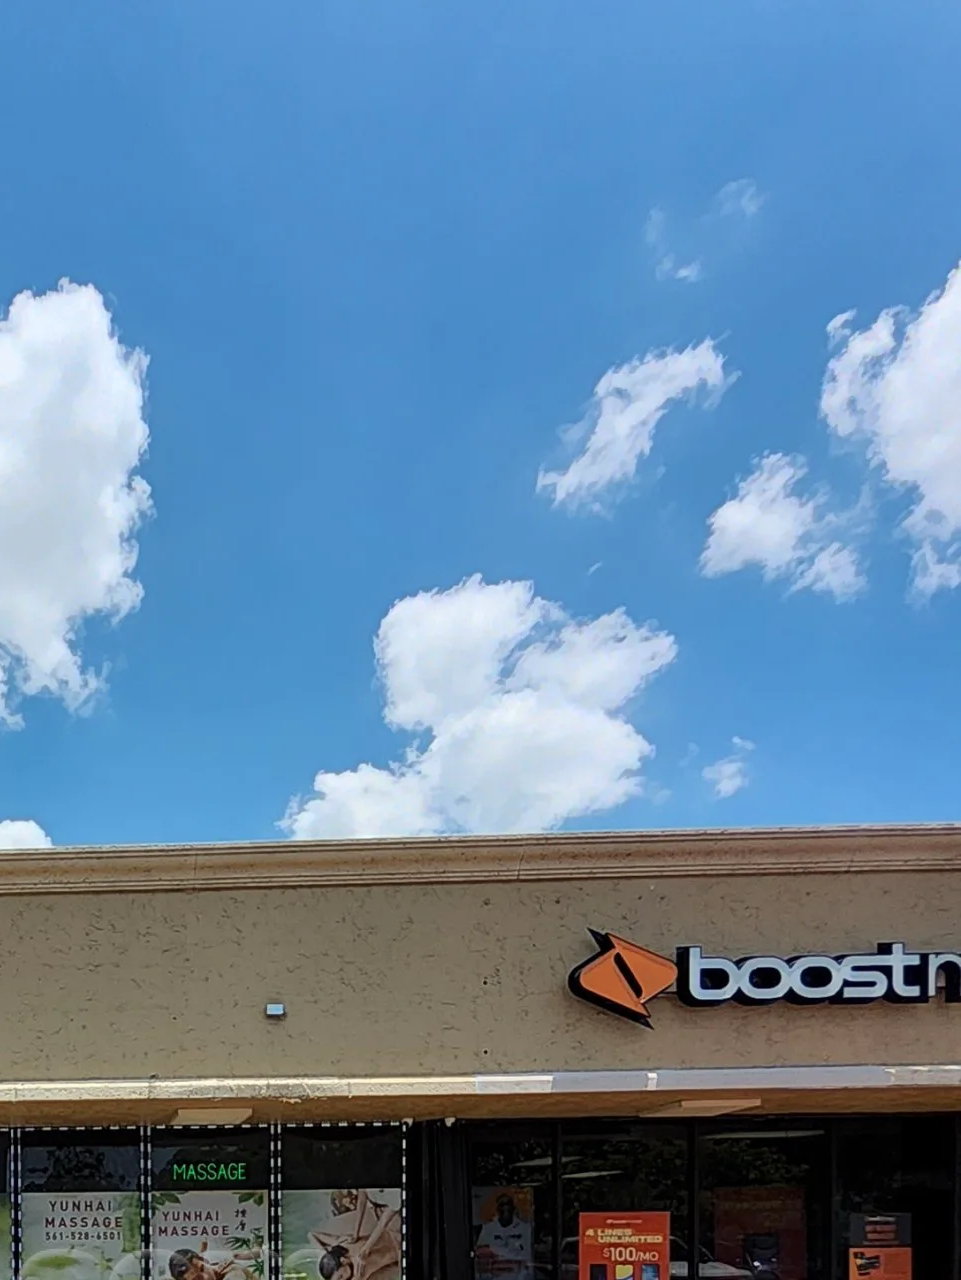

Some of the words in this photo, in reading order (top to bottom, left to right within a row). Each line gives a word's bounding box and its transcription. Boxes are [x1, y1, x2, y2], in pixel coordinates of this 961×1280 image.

[173, 1162, 247, 1181] MASSAGE
[48, 1199, 112, 1212] YUNHAI
[161, 1209, 220, 1221] YUNHAI
[44, 1216, 123, 1230] MASSAGE
[45, 1231, 122, 1241] 561-528-6501
[158, 1225, 230, 1237] MASSAGE
[585, 1228, 595, 1236] 4
[597, 1228, 632, 1236] LINES
[603, 1247, 659, 1261] $100/MO
